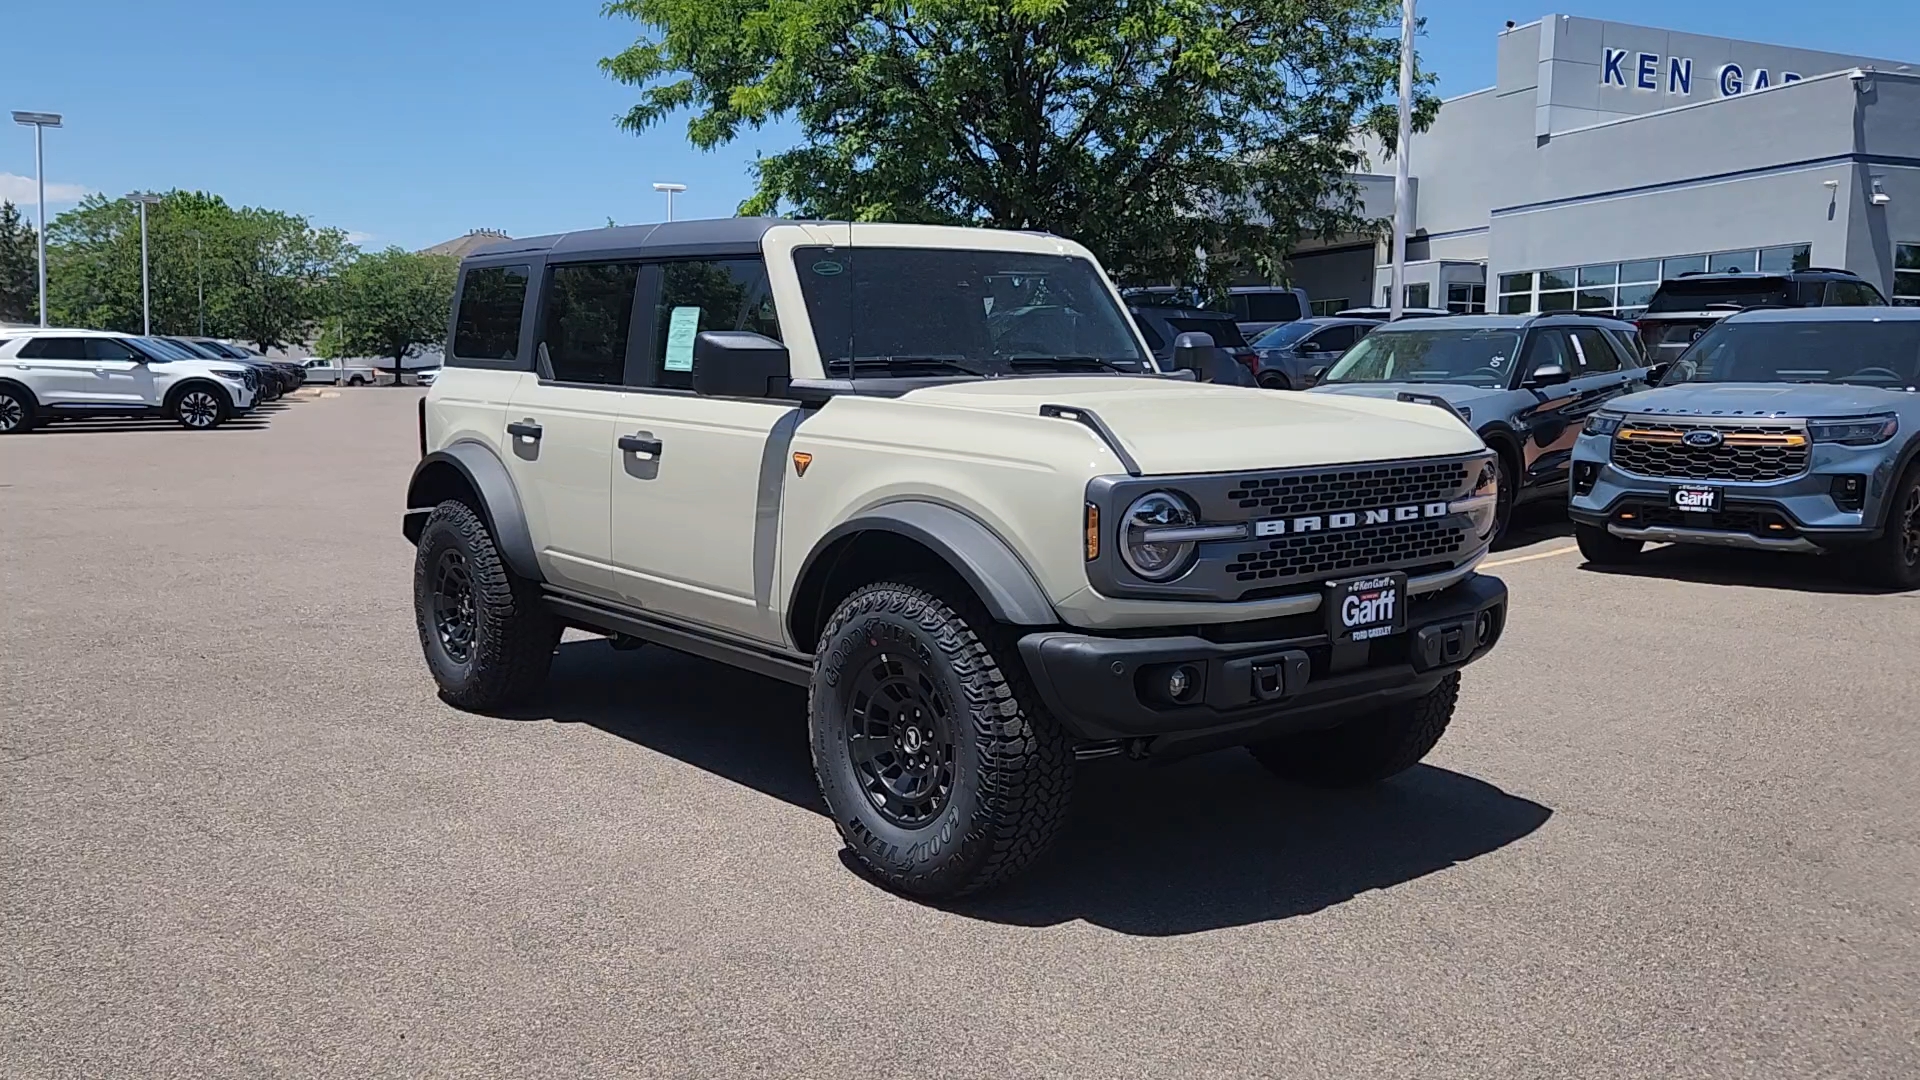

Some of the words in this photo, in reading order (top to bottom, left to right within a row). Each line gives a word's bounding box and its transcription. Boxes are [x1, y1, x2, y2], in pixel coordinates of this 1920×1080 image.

[1603, 47, 1692, 96] KEN
[1675, 490, 1714, 507] Garff
[1255, 502, 1448, 537] BRONCO
[1342, 589, 1395, 627] Garff
